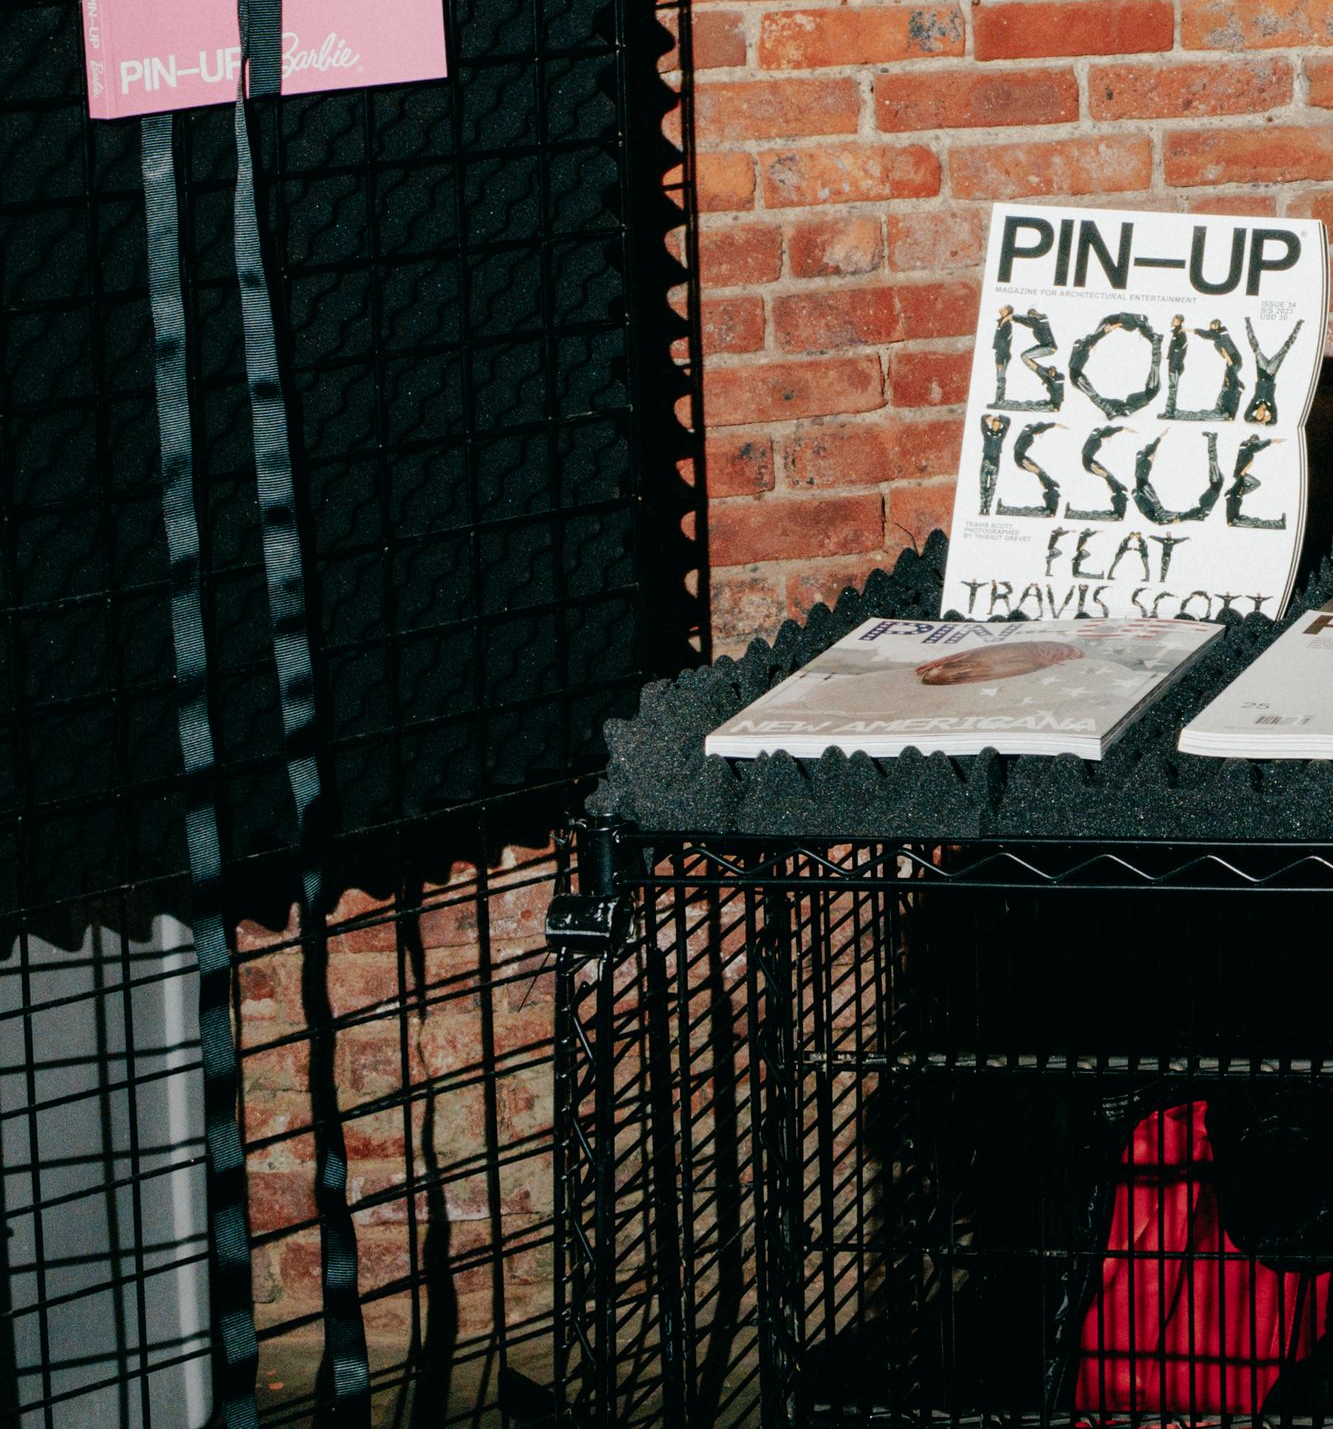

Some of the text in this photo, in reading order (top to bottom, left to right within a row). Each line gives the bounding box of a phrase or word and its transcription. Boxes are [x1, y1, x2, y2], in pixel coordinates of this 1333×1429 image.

[995, 287, 1197, 305] MAGAZINE FOR ARCHITECTURAL ENTERTAINMENT
[1261, 300, 1286, 308] ISSUE
[986, 304, 1305, 425] BODY
[979, 414, 1287, 530] ISSUE
[964, 527, 1020, 535] PHOTOGRAPHED
[1045, 526, 1190, 582] FEAT
[960, 578, 1274, 620] TRAVIS SCOTT
[729, 715, 1096, 733] NEW AMERICANA
